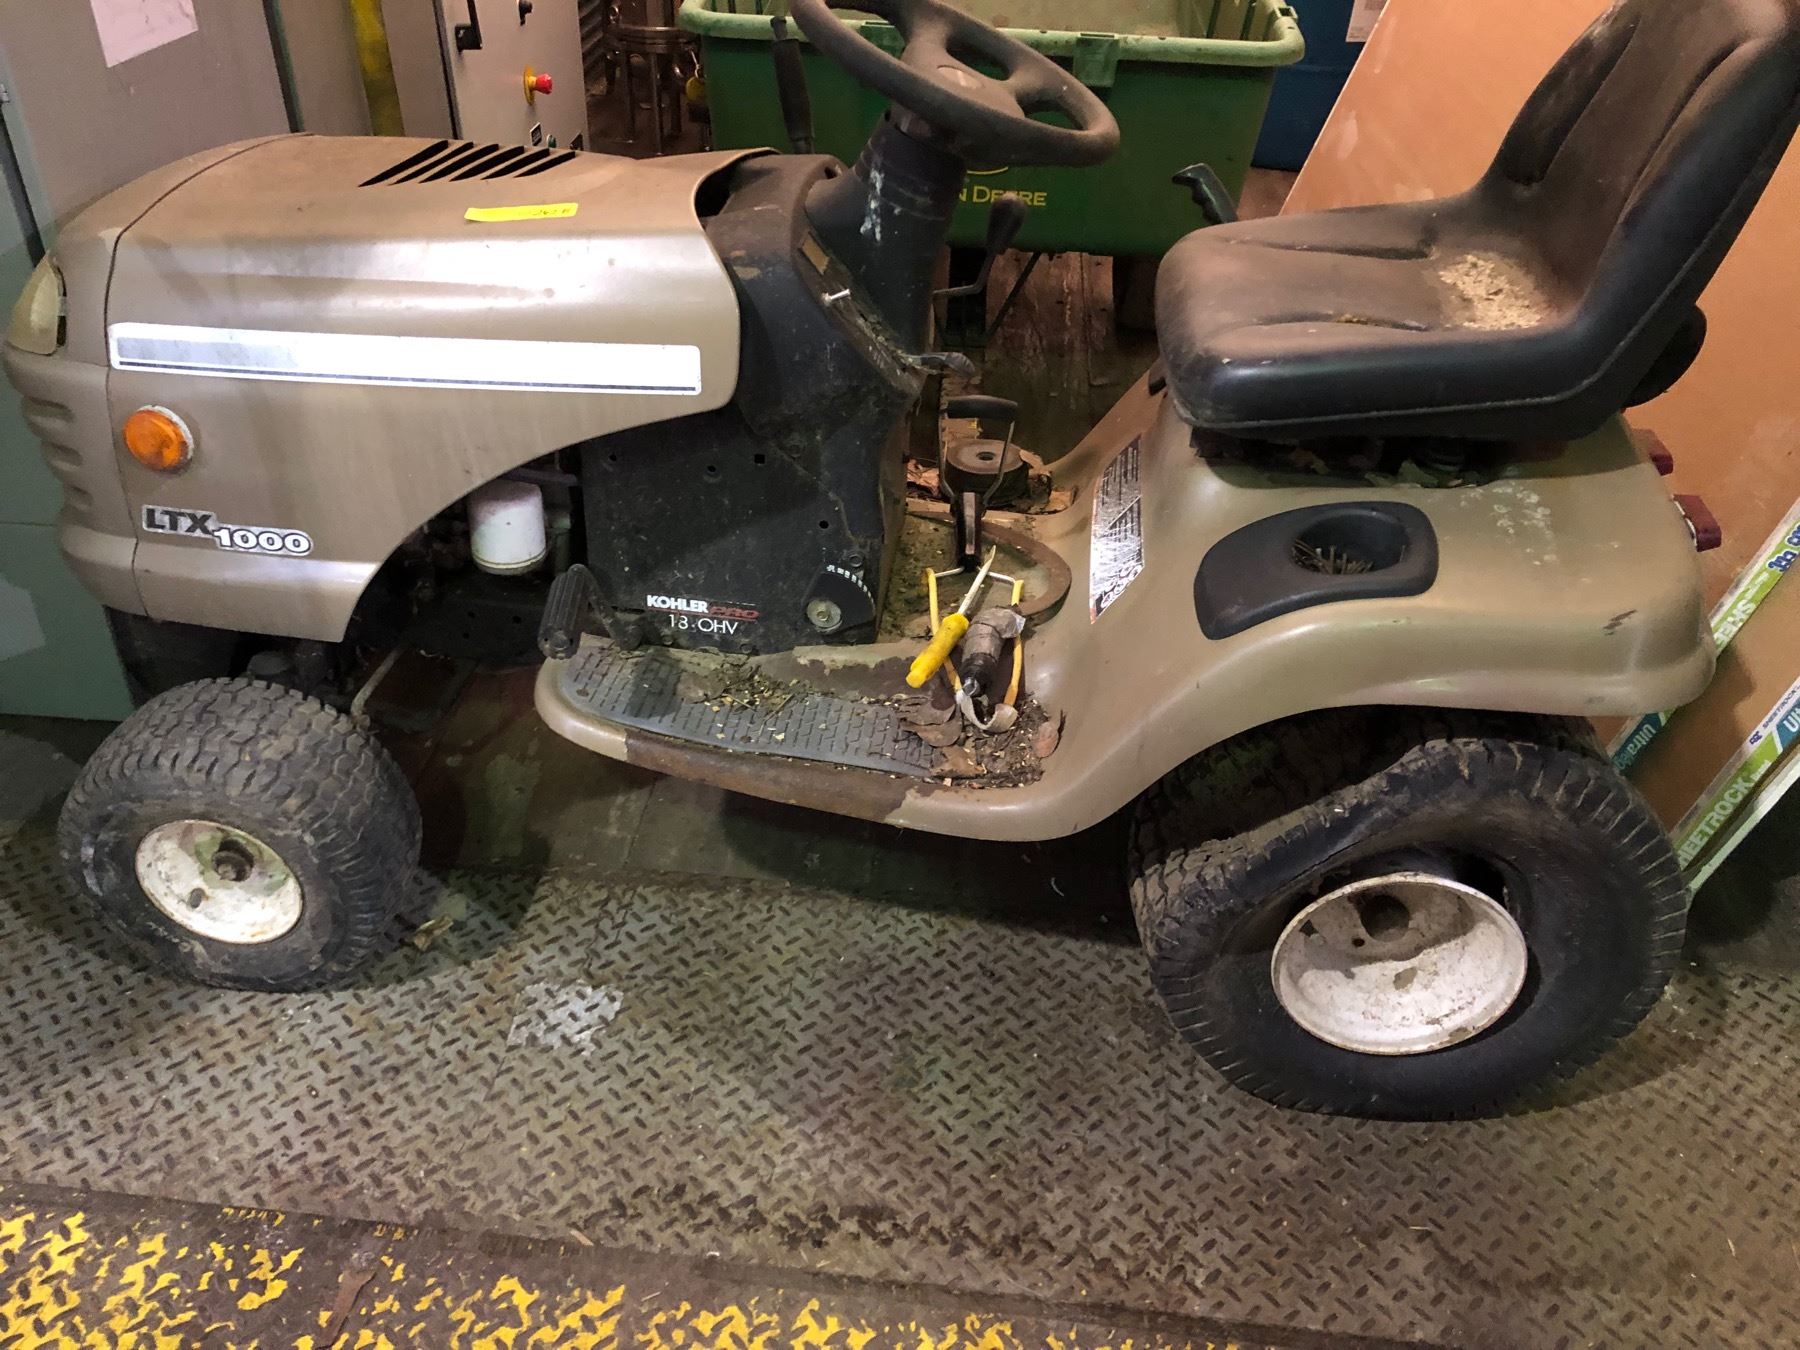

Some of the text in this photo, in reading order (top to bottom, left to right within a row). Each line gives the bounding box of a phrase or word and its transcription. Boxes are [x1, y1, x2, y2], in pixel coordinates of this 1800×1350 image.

[973, 185, 1048, 206] DERE
[146, 508, 311, 554] LTX 1000
[647, 594, 708, 613] KOHLER
[697, 618, 739, 635] OHV
[1678, 777, 1750, 870] HEETROCK
